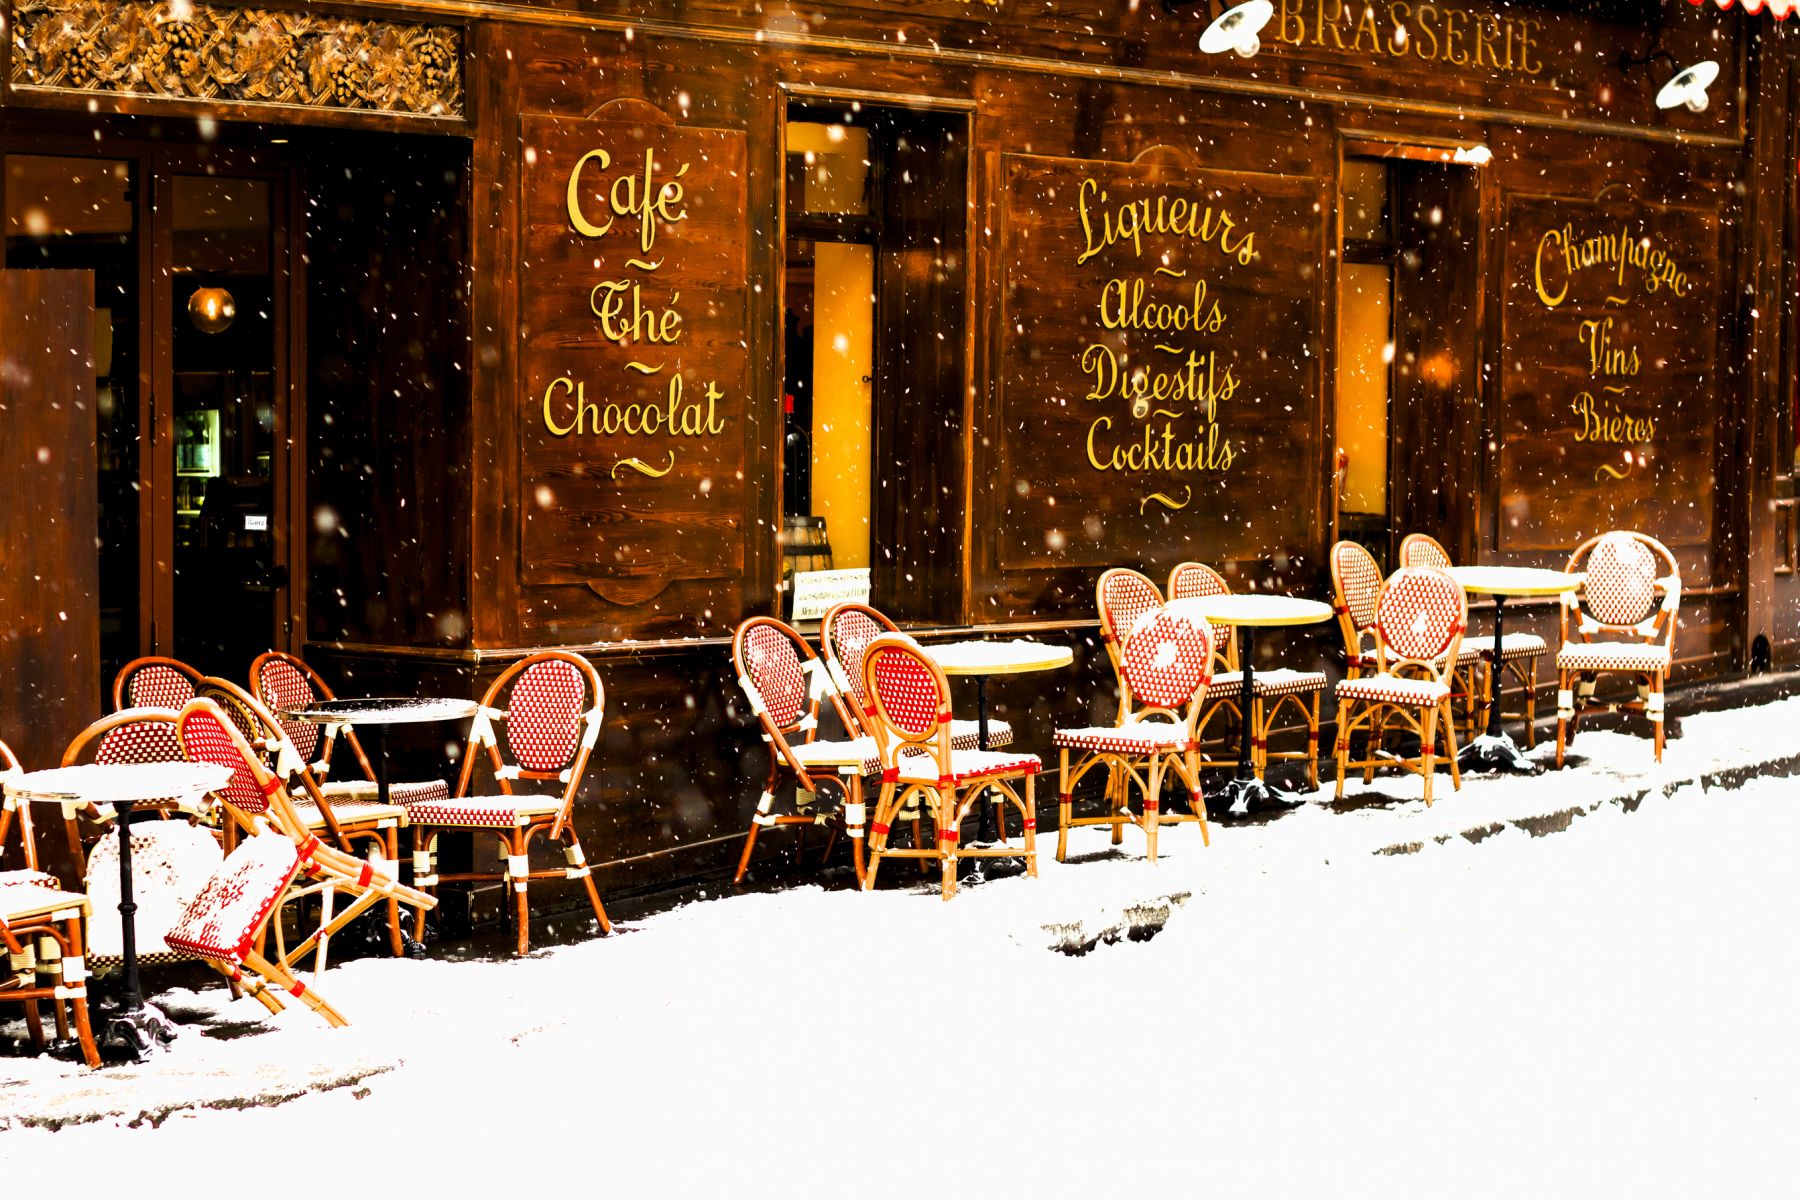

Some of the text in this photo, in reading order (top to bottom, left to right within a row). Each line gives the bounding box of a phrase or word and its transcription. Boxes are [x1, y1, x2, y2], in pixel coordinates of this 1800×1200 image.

[1275, 0, 1542, 74] BRASSERIE
[566, 147, 690, 253] Café
[1077, 178, 1260, 265] Liqueurs
[1535, 222, 1687, 306] Champagne
[591, 280, 681, 343] Thé
[1100, 278, 1226, 332] Alcools
[1579, 317, 1640, 375] Vins
[544, 373, 725, 435] Chocolat
[1081, 344, 1240, 423] Digestifs
[1086, 416, 1237, 471] Cocktails
[1573, 392, 1655, 442] Bières
